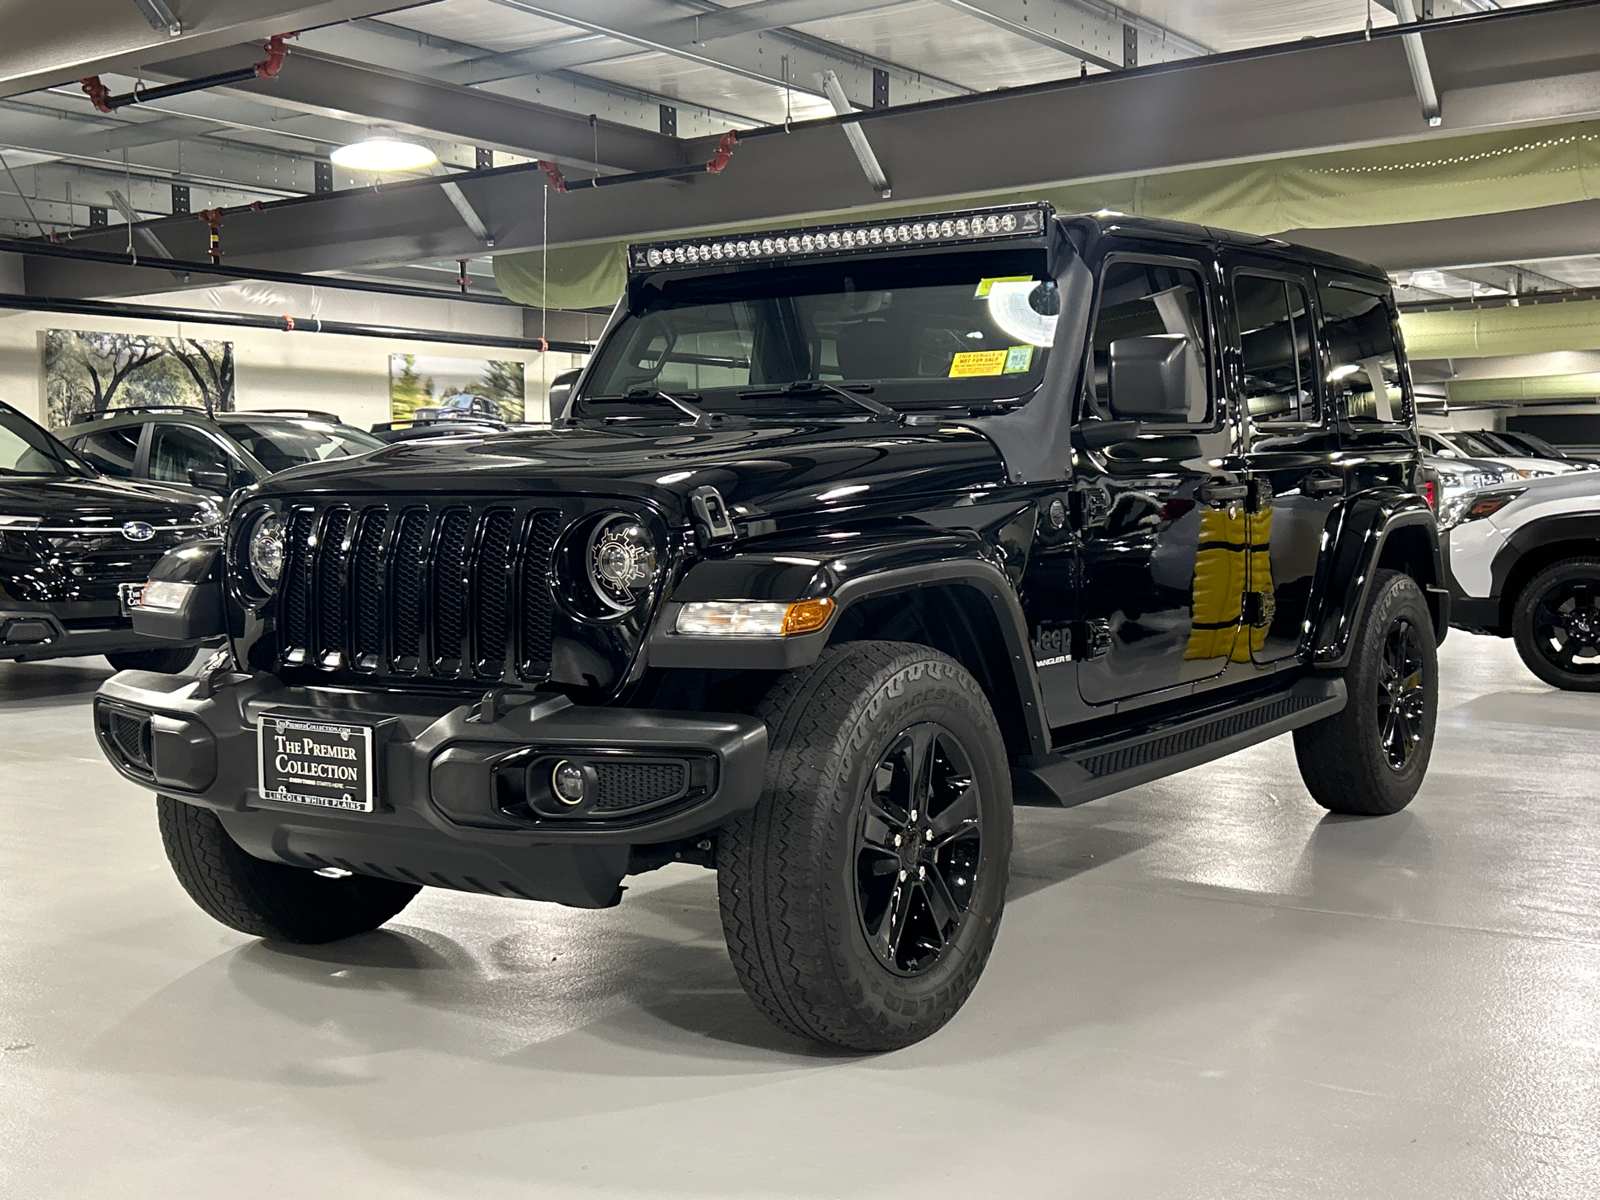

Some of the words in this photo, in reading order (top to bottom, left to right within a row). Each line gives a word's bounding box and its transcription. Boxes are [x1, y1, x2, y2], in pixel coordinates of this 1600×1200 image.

[1031, 625, 1072, 654] Jeep
[866, 687, 989, 763] BRIDGESTONE
[274, 735, 303, 755] THE
[302, 738, 357, 760] PREMIER
[275, 754, 358, 780] COLLECTION
[289, 777, 316, 786] EVERYTHING
[269, 792, 302, 802] LINCOLN
[305, 796, 329, 806] WHITE
[333, 799, 361, 810] PLAINS
